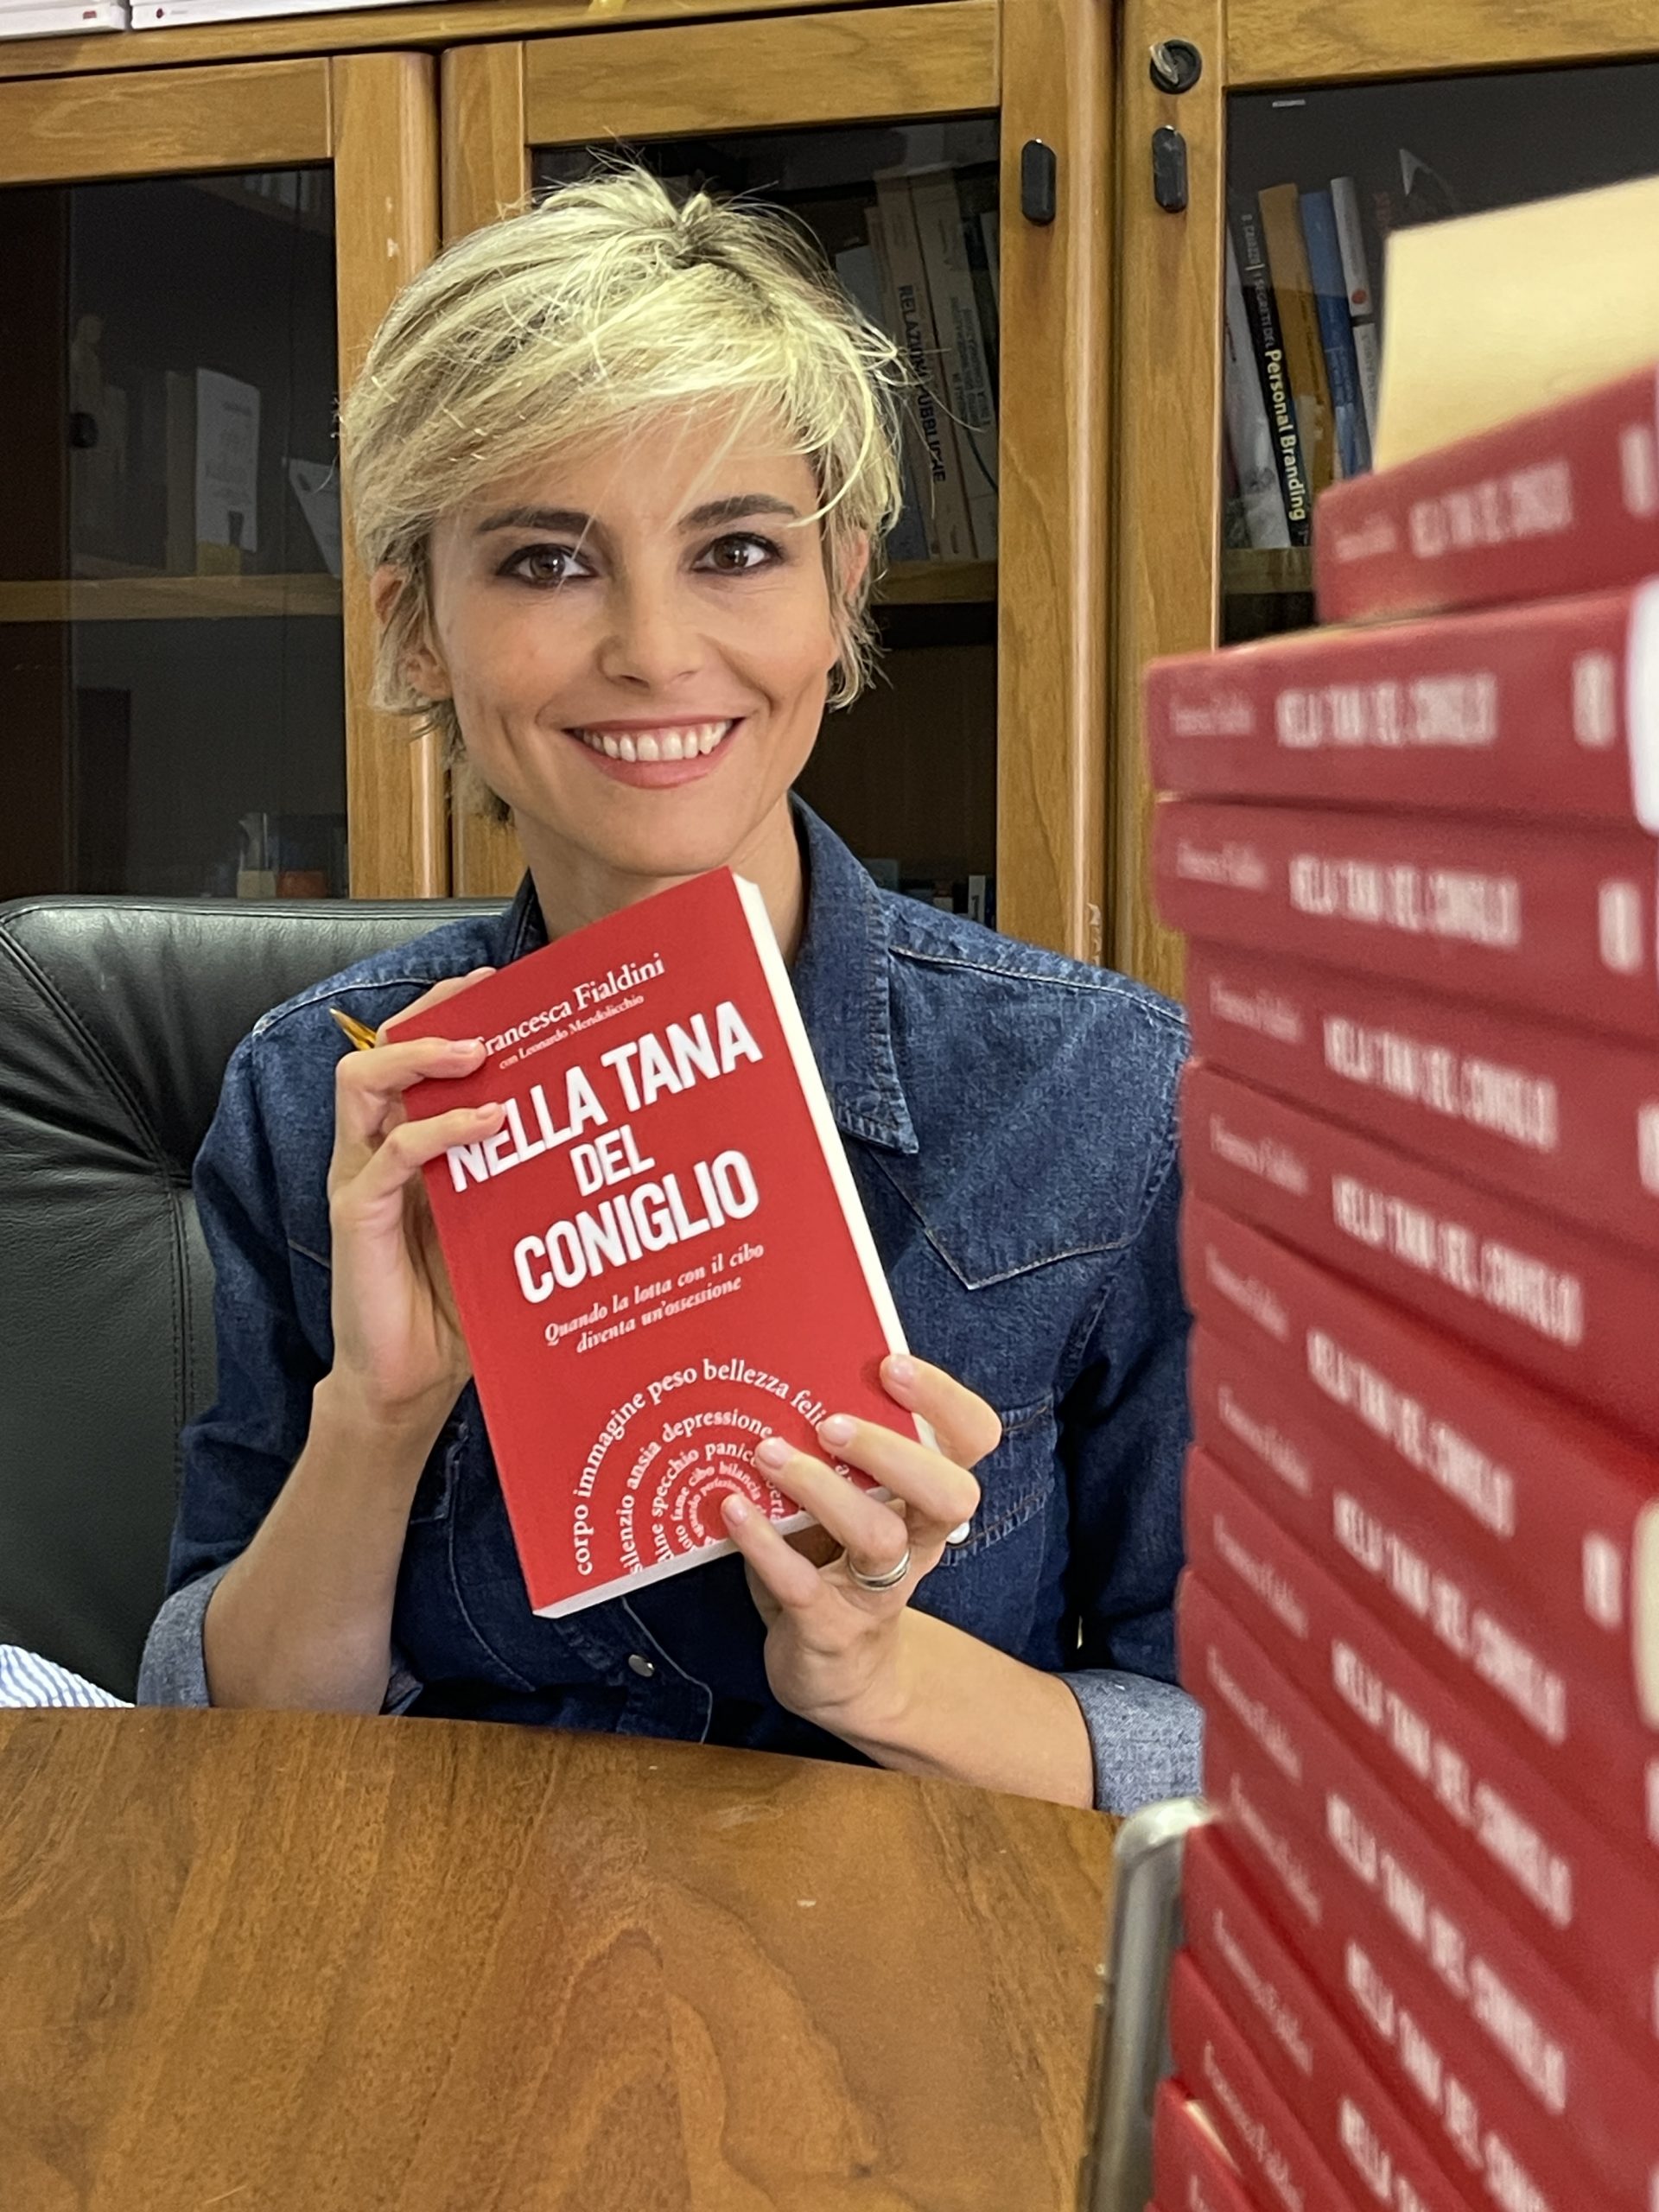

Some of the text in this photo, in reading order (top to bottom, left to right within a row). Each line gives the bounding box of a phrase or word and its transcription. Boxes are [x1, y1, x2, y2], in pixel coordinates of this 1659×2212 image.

[899, 285, 946, 483] RELAZIONI PUBBLICHE
[1264, 348, 1287, 433] Personal
[1280, 435, 1306, 522] Branding
[479, 952, 664, 1057] rancesca Fialdini
[499, 1053, 518, 1070] con
[518, 1028, 569, 1059] Leonardo
[445, 1000, 764, 1193] NELLA TANA
[569, 1123, 656, 1198] DEL
[513, 1149, 760, 1304] CONIGLIO
[544, 1243, 765, 1346] Quando la lotta con il cibo
[576, 1317, 636, 1353] diventa
[647, 1367, 698, 1406] peso
[702, 1357, 791, 1400] bellezza
[572, 1392, 647, 1498] immagine
[652, 1448, 700, 1517] specchio
[616, 1408, 773, 1574] silenzio ansia depressione
[670, 1486, 690, 1522] fame
[689, 1465, 715, 1487] cibo
[719, 1460, 761, 1501] bilancia
[573, 1503, 594, 1576] corpo
